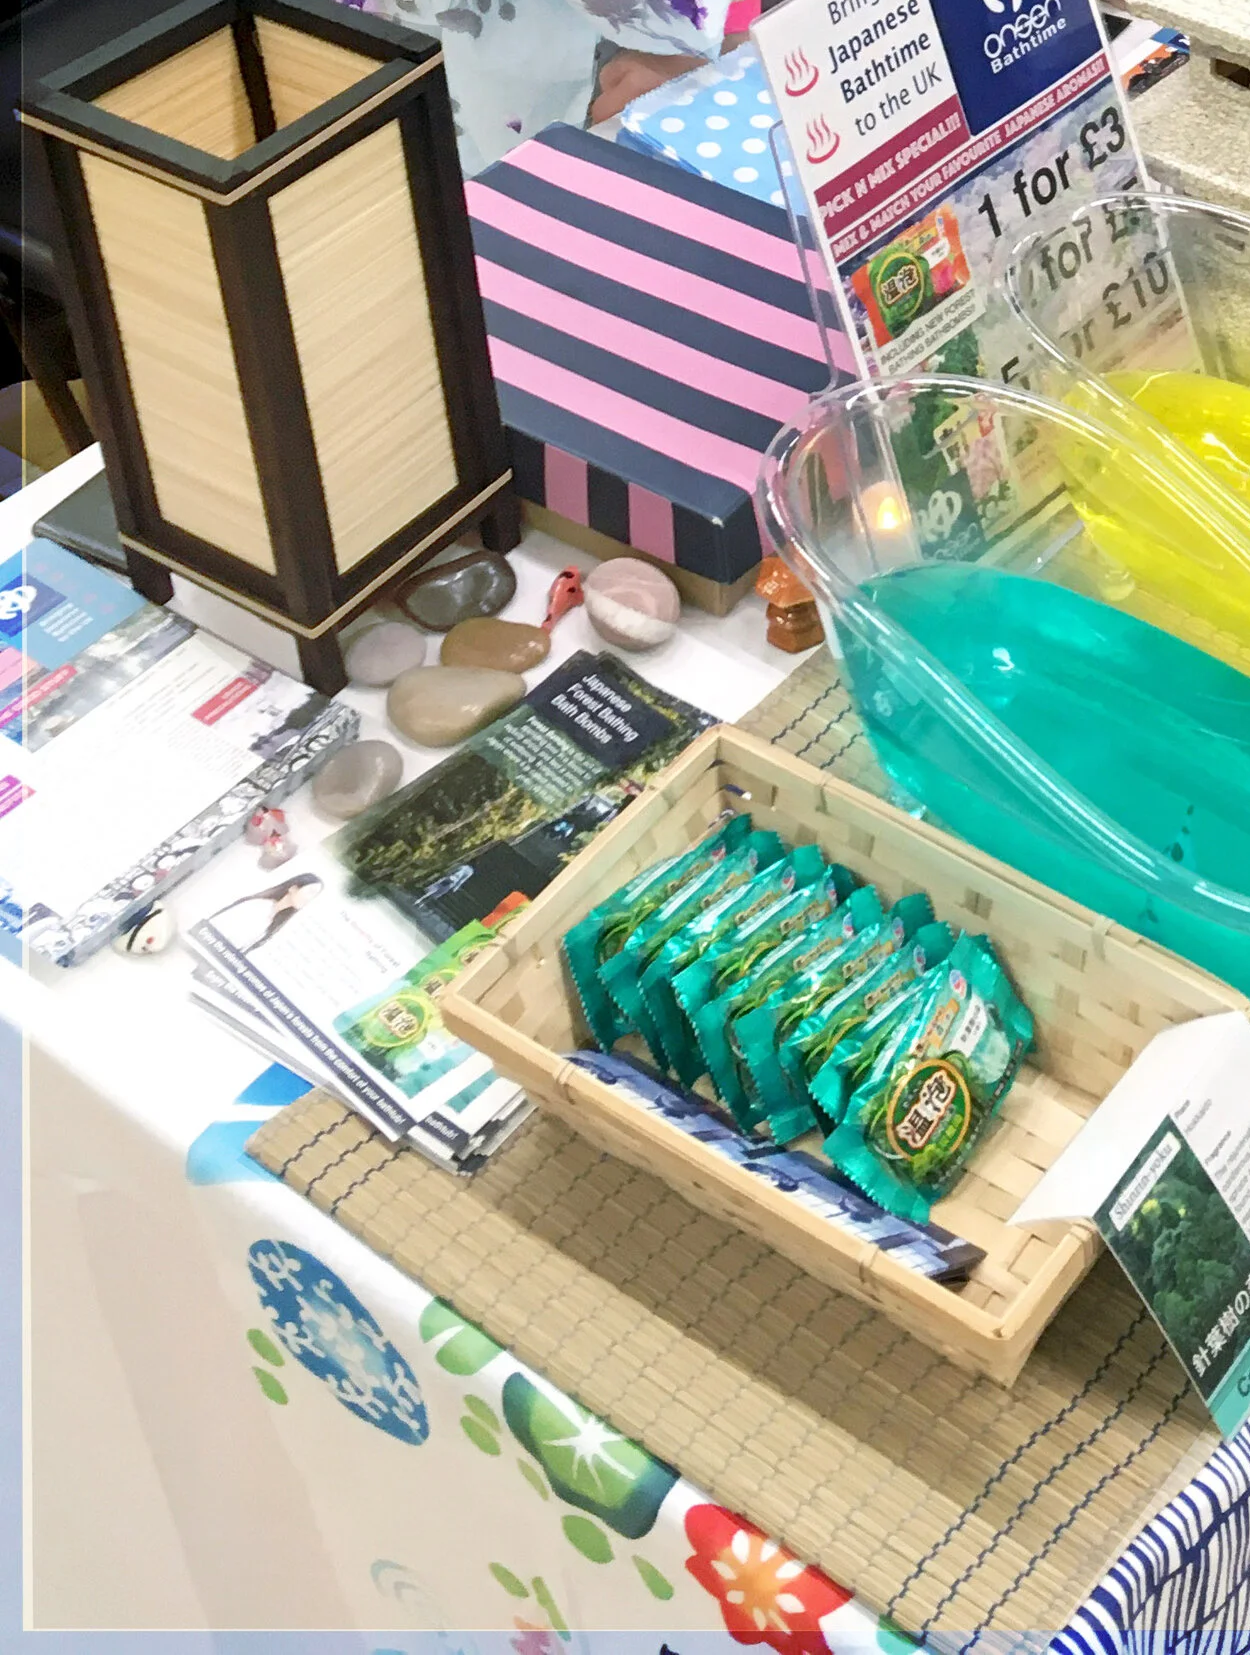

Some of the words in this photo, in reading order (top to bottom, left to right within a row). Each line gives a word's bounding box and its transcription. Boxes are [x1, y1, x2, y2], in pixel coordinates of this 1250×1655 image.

[840, 32, 931, 104] Bathtime
[990, 18, 1067, 74] Bathtime
[855, 112, 877, 137] to
[879, 88, 912, 120] the
[912, 61, 942, 95] UK
[818, 187, 855, 222] PICK
[854, 178, 868, 199] N
[867, 158, 896, 189] MIX
[832, 233, 859, 258] MIX
[858, 225, 870, 240] &
[869, 194, 911, 232] MATCH
[909, 173, 943, 203] YOUR
[941, 125, 1003, 180] FAVOURITE
[1004, 93, 1057, 138] JAPANESE
[977, 193, 1002, 239] 1
[1012, 149, 1070, 218] for
[1079, 106, 1126, 171] £3
[880, 329, 925, 366] INCLUDING
[924, 312, 945, 331] NEW
[944, 288, 976, 317] FOREST
[888, 343, 926, 375] BATHING
[551, 694, 578, 718] Bath
[574, 711, 613, 744] Bombs
[566, 683, 604, 713] Forest
[597, 706, 639, 743] Bathing
[582, 674, 632, 713] Japanese
